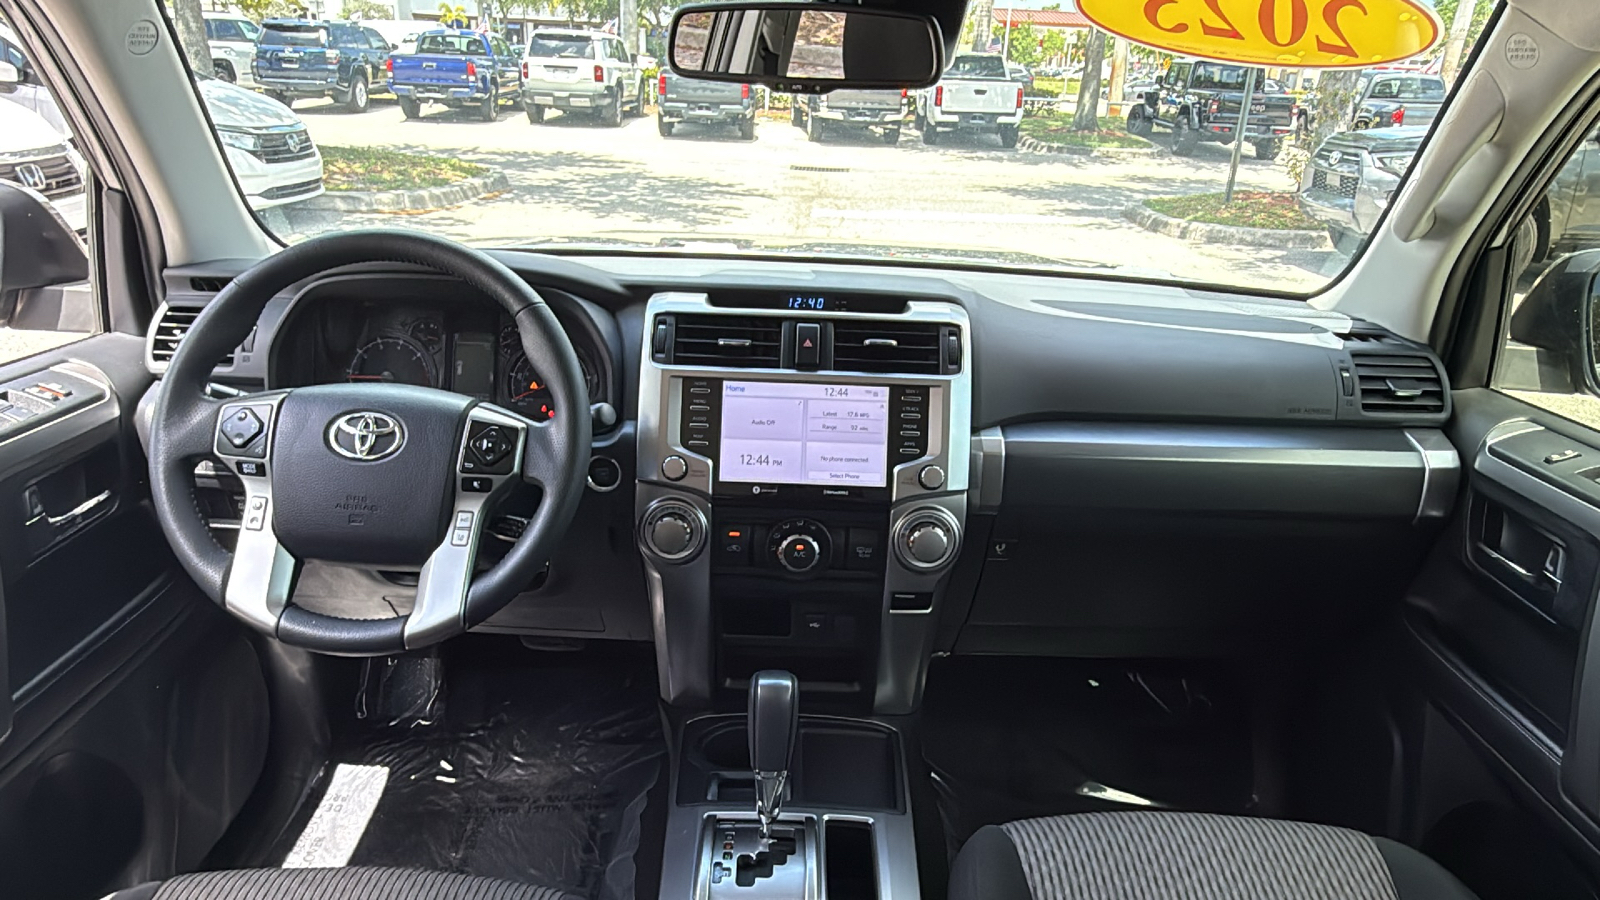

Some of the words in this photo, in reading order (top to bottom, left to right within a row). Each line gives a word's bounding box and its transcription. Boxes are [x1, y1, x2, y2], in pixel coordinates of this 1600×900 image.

[788, 297, 825, 309] 12:40
[725, 385, 746, 393] Home
[824, 387, 849, 398] 12:44
[821, 423, 838, 432] Range
[740, 453, 770, 467] 12:44
[772, 459, 783, 467] PM
[829, 455, 844, 463] phone
